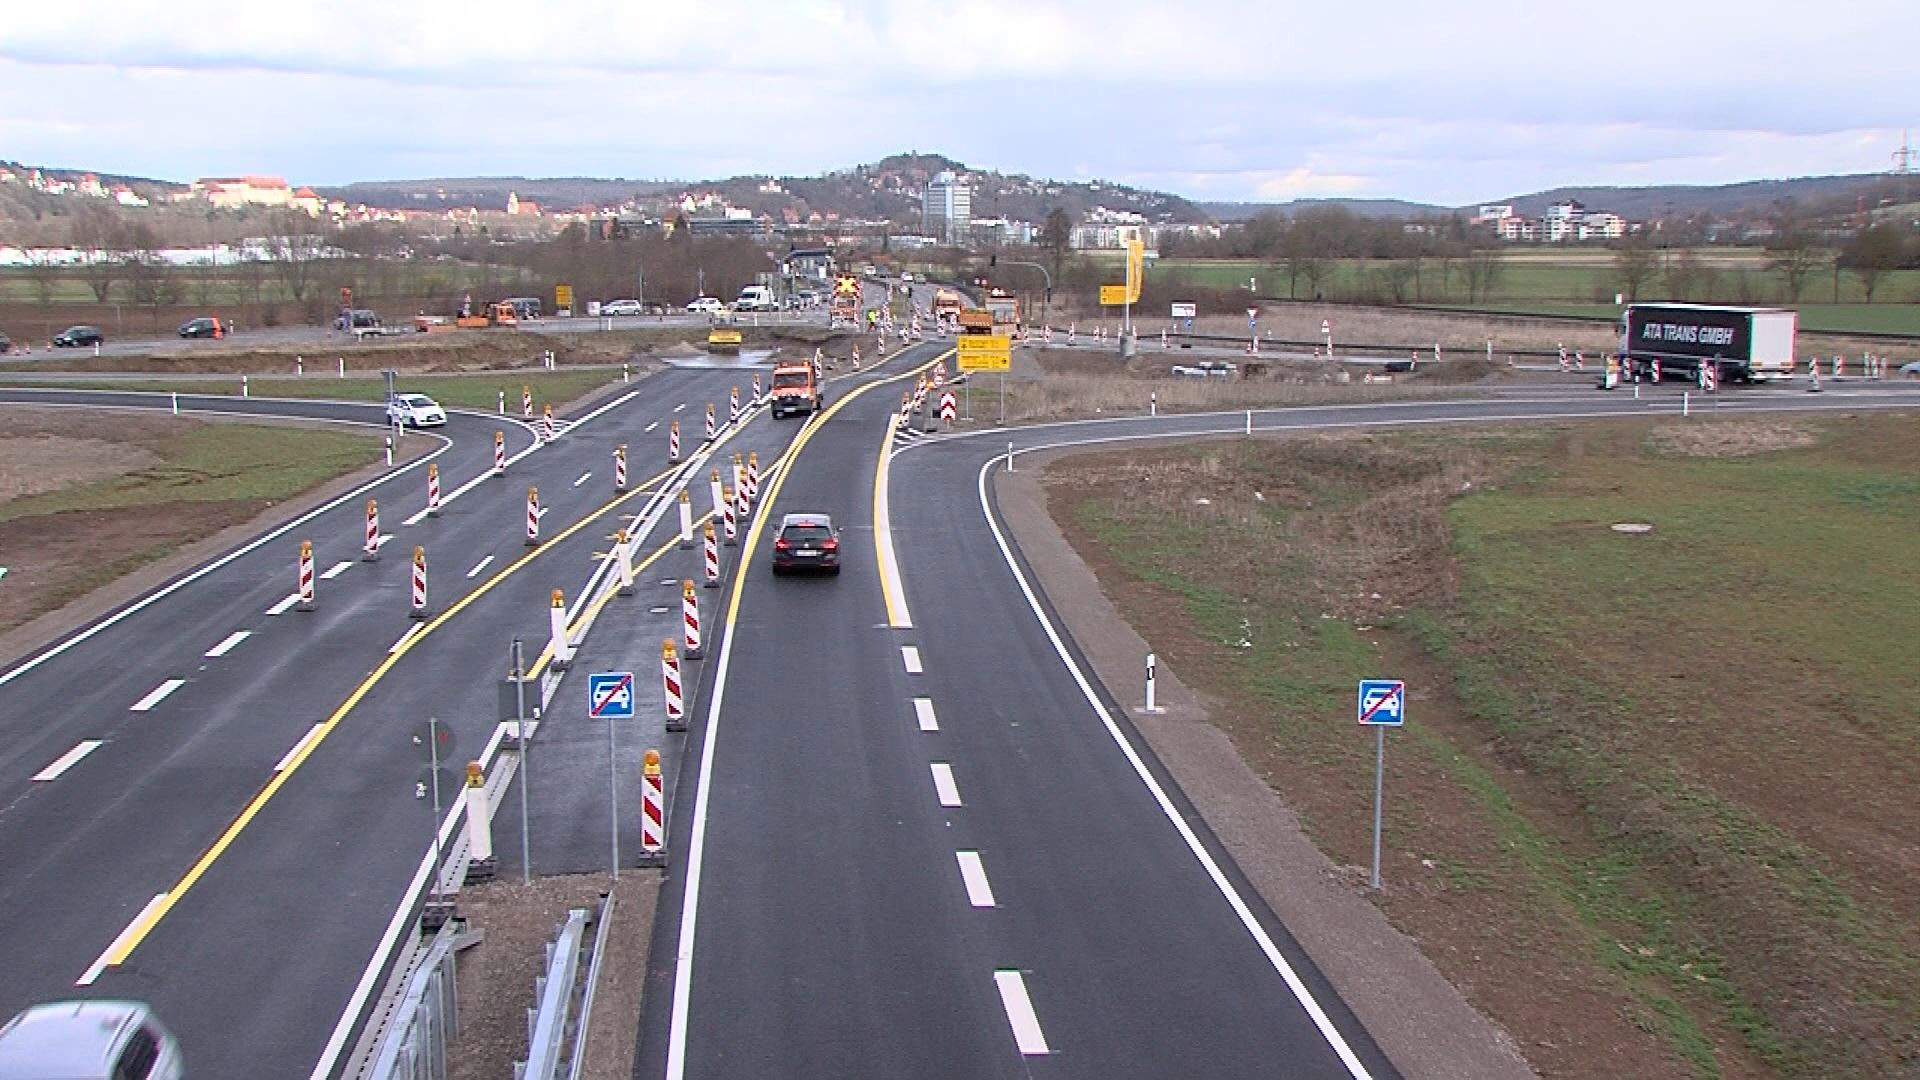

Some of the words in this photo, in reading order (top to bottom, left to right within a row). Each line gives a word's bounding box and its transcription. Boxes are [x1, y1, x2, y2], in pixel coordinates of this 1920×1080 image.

[1643, 323, 1662, 340] ATA
[1664, 324, 1697, 343] TRANS
[1699, 326, 1735, 345] GMBH
